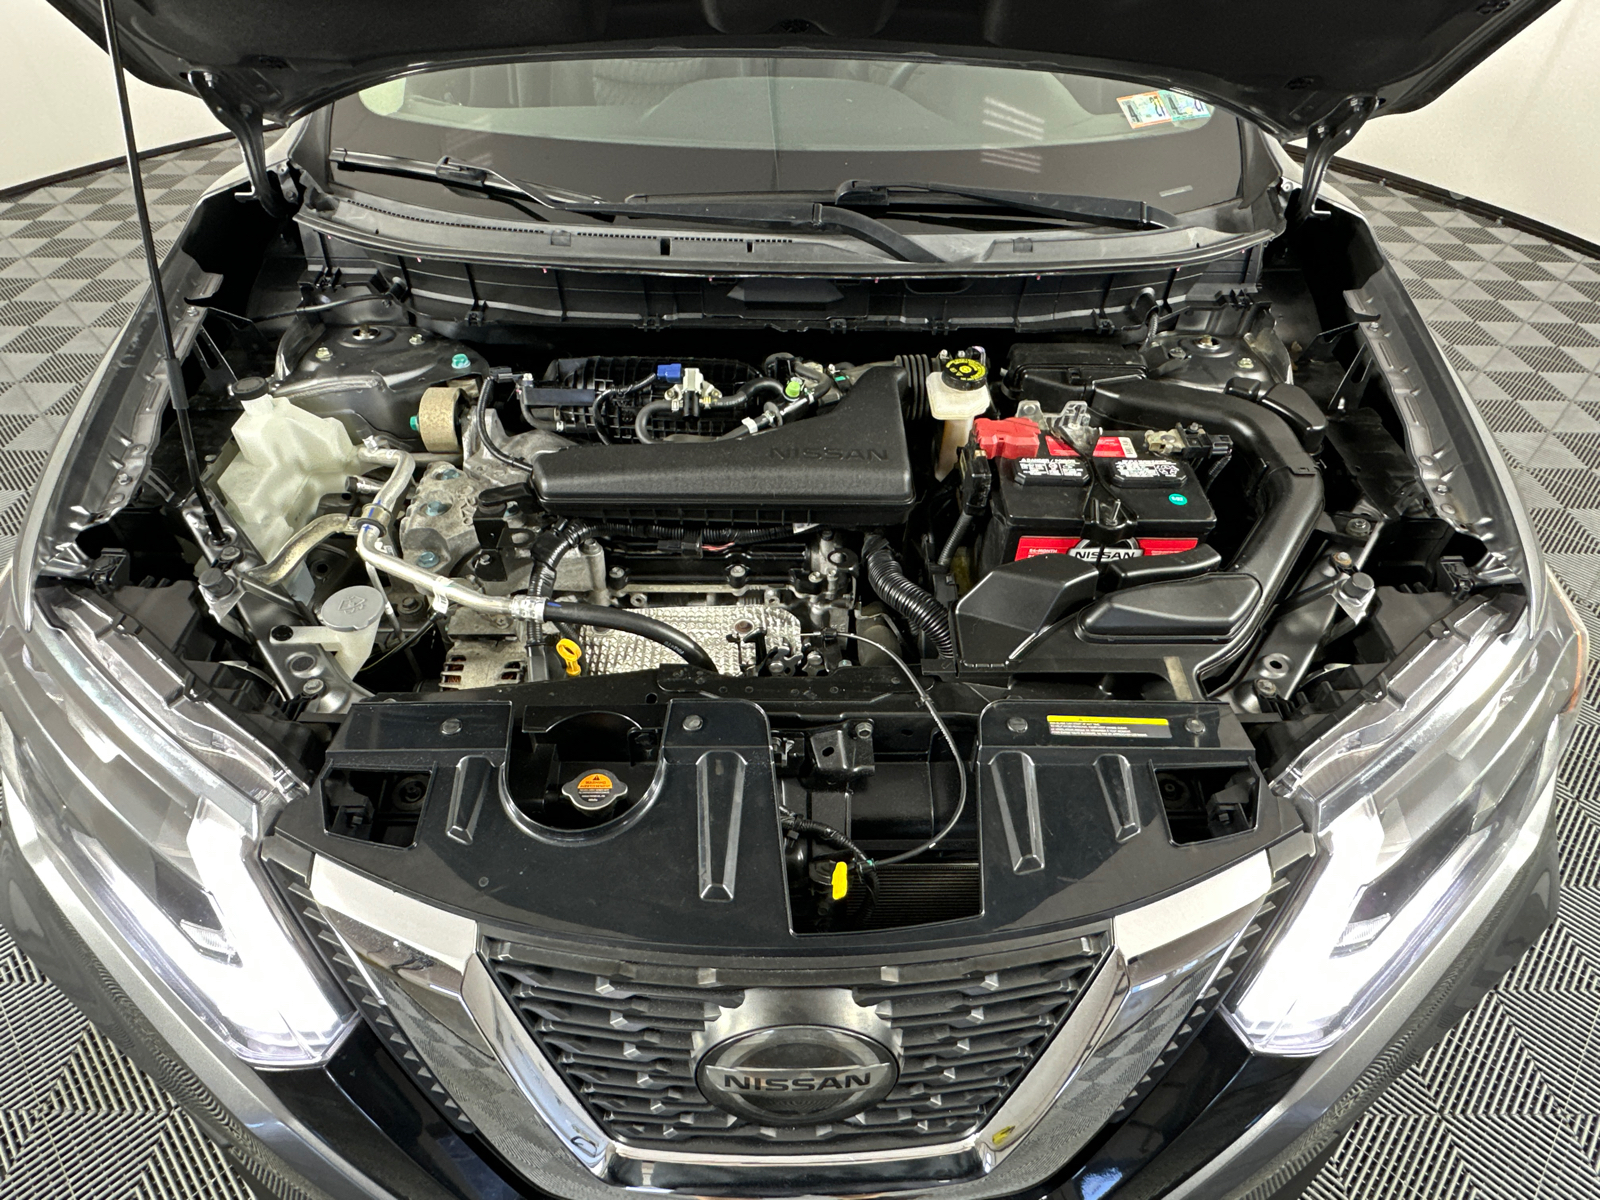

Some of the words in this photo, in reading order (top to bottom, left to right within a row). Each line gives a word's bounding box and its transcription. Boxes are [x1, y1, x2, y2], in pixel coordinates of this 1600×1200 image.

[769, 447, 889, 460] NISSAN
[1075, 551, 1135, 559] NISSAN
[724, 1072, 871, 1092] NISSAN
